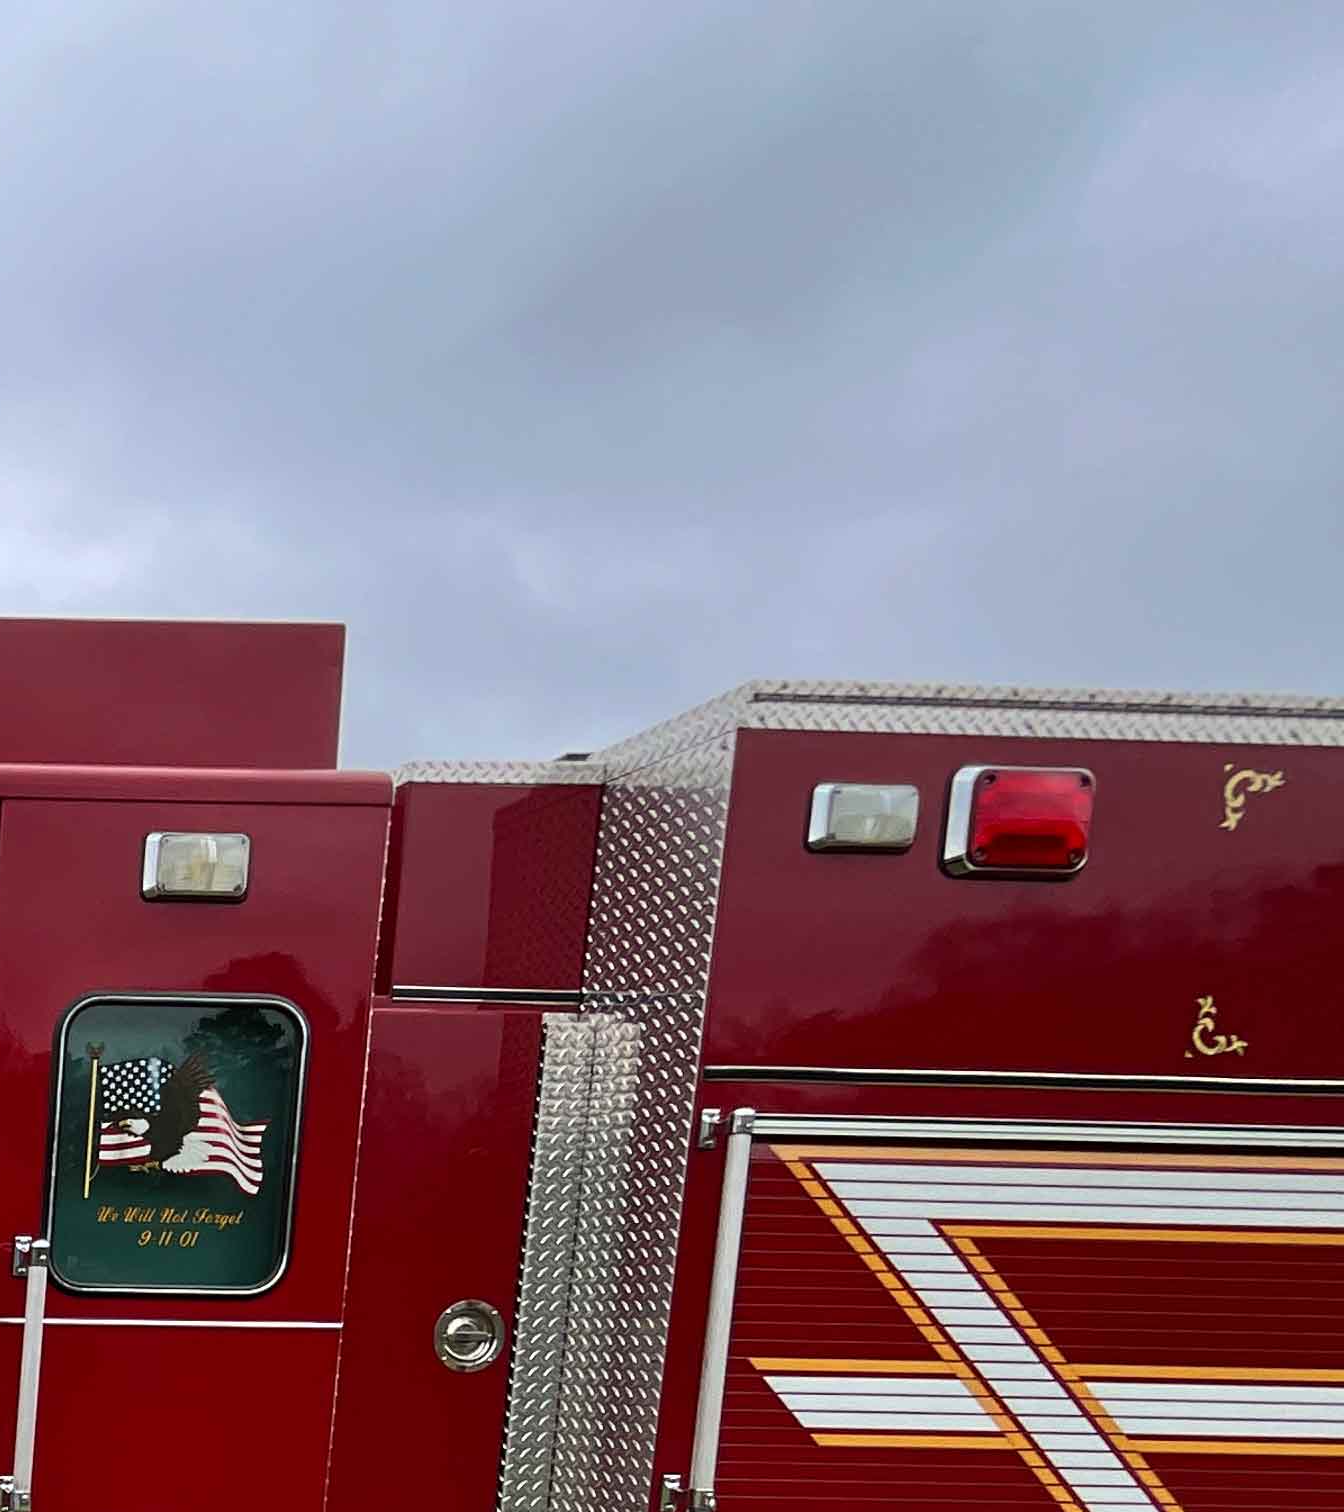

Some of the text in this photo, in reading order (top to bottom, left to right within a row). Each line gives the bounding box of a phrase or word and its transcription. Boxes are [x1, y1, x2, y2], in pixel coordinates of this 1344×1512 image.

[97, 1205, 245, 1230] We Will Not Forget
[137, 1229, 200, 1247] 9-11-01
